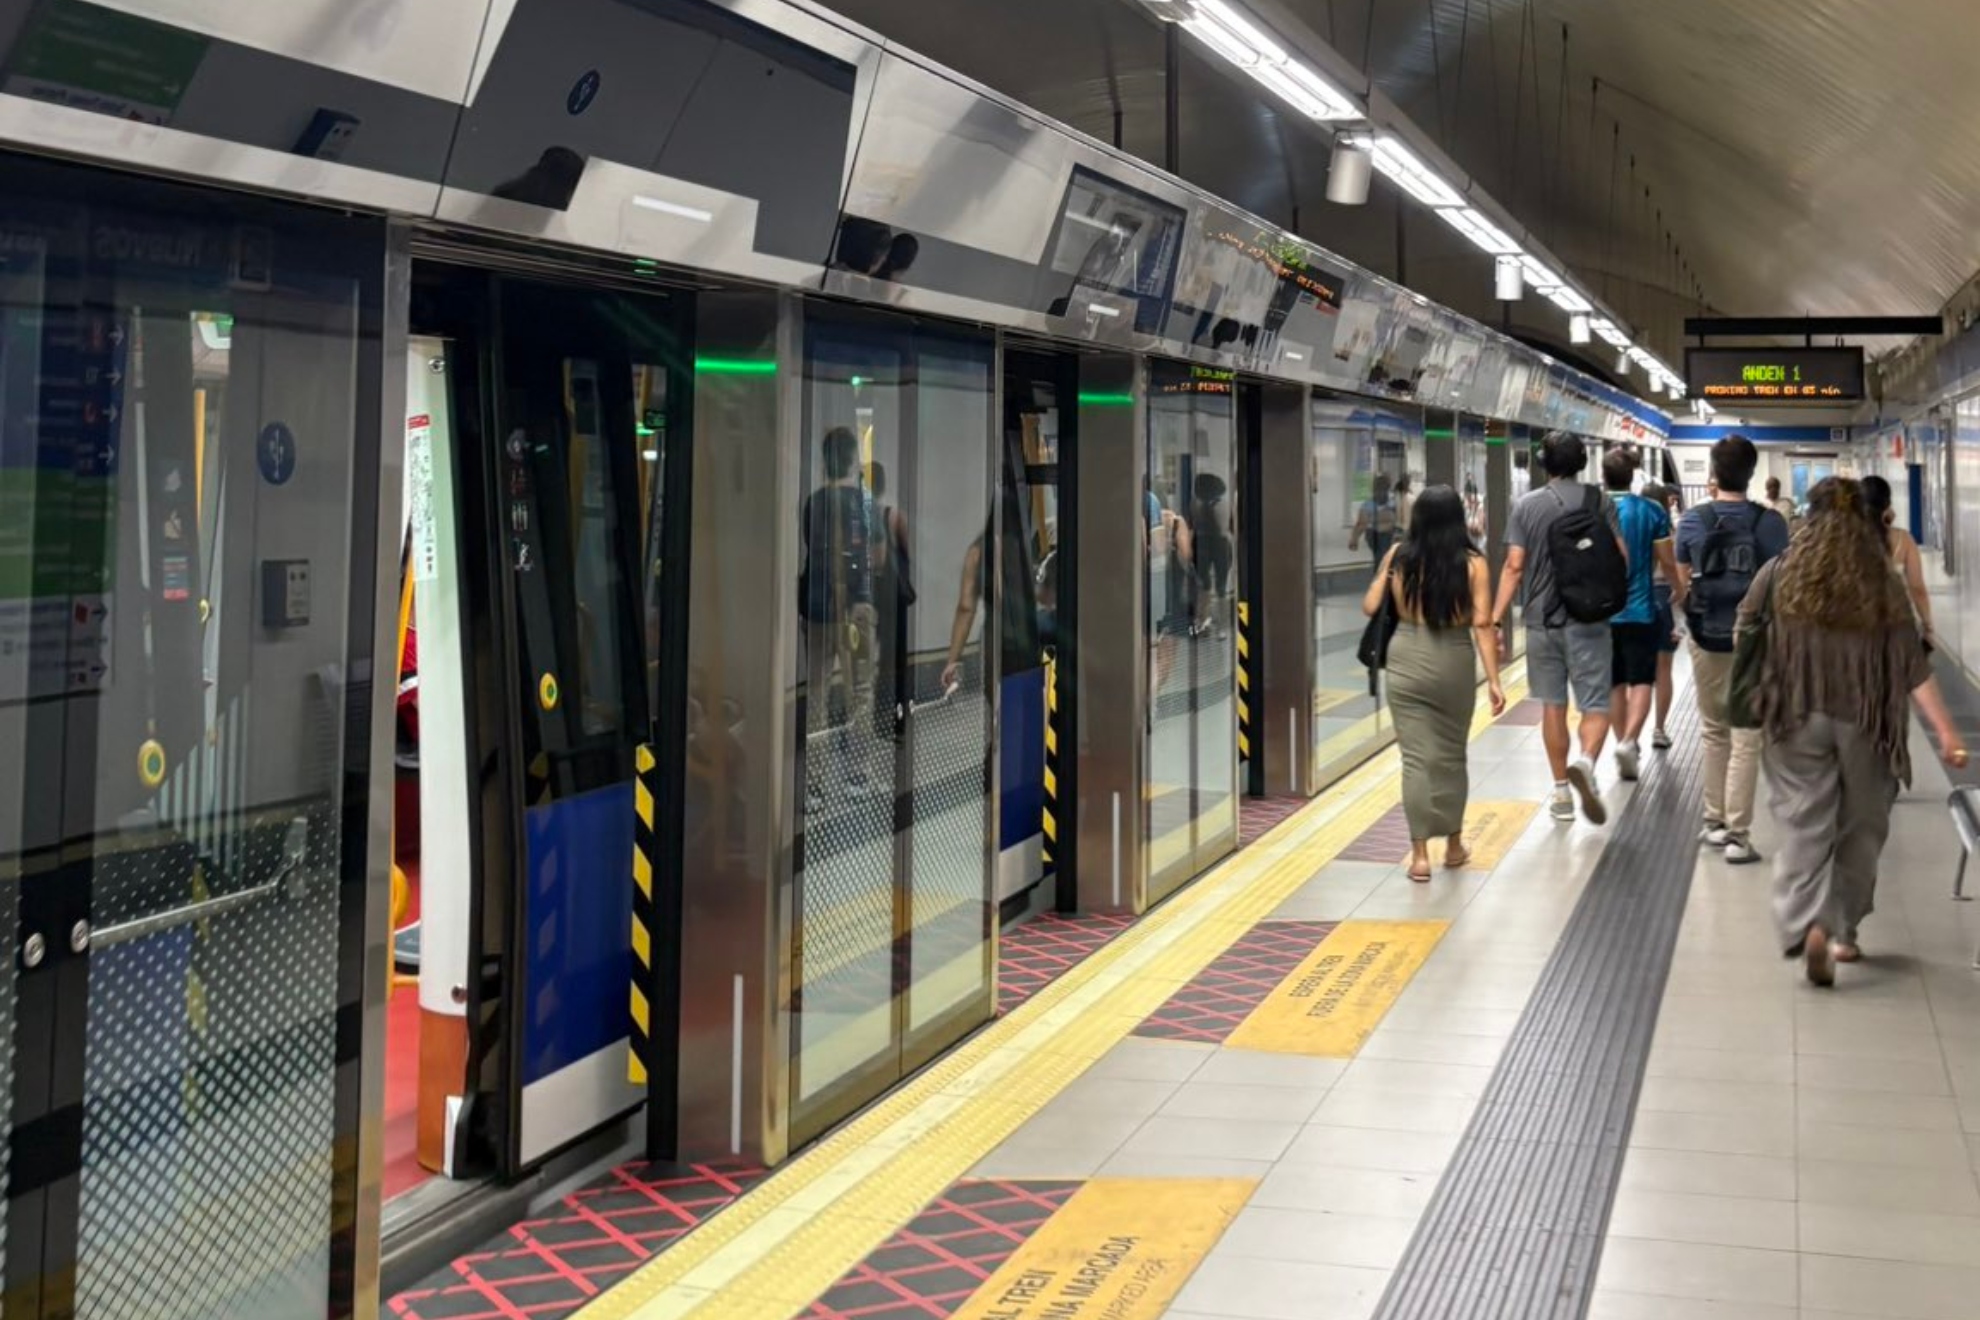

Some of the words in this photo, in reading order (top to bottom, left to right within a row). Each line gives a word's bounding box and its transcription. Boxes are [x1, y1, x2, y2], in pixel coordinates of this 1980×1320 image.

[1742, 365, 1785, 381] ANDEN
[1793, 365, 1801, 381] 1
[1753, 385, 1779, 395] TREN
[1820, 385, 1842, 395] min
[1059, 1236, 1141, 1298] MARCADA
[997, 1268, 1058, 1305] TREN
